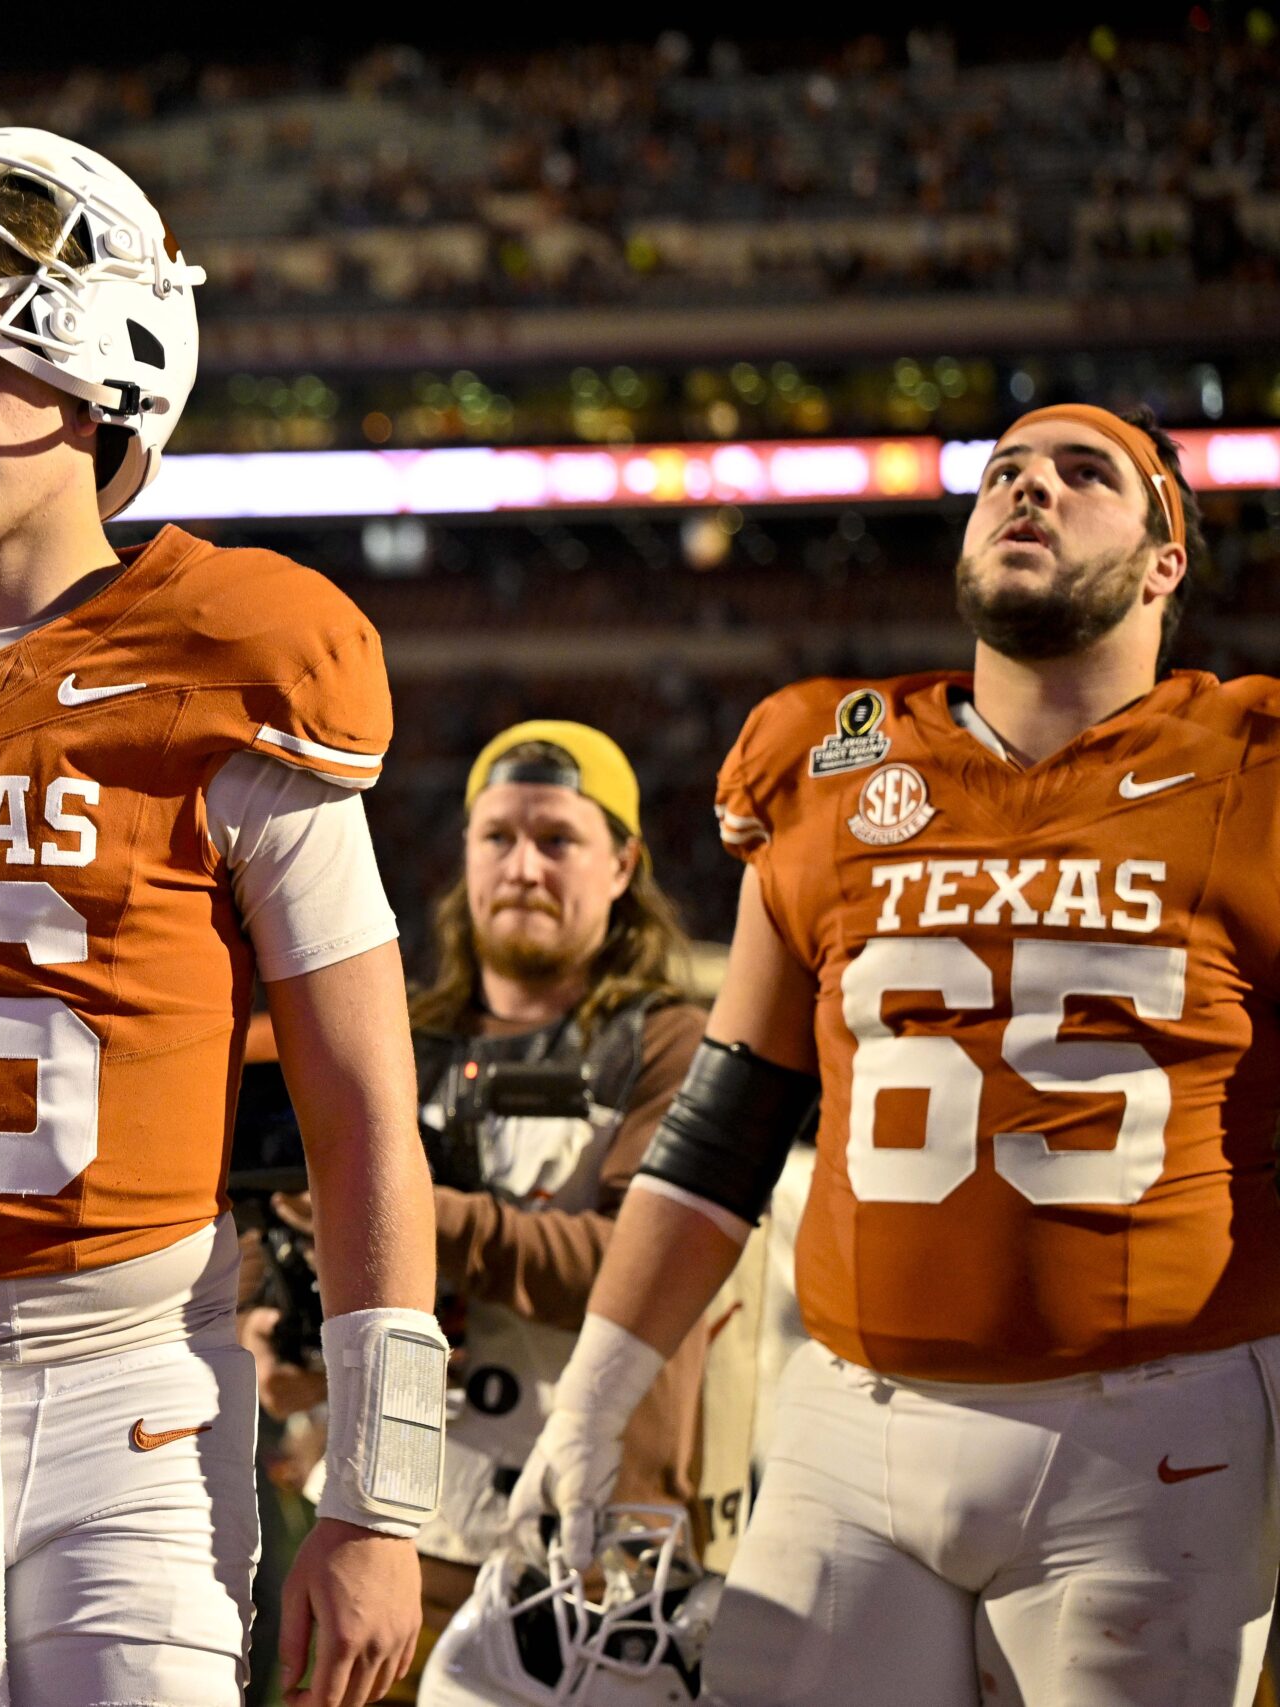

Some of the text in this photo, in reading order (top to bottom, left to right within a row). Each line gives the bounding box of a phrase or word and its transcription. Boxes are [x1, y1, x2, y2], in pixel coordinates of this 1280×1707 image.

[866, 768, 919, 826] SEC
[872, 859, 1166, 933] TEXAS
[841, 937, 1187, 1205] 65
